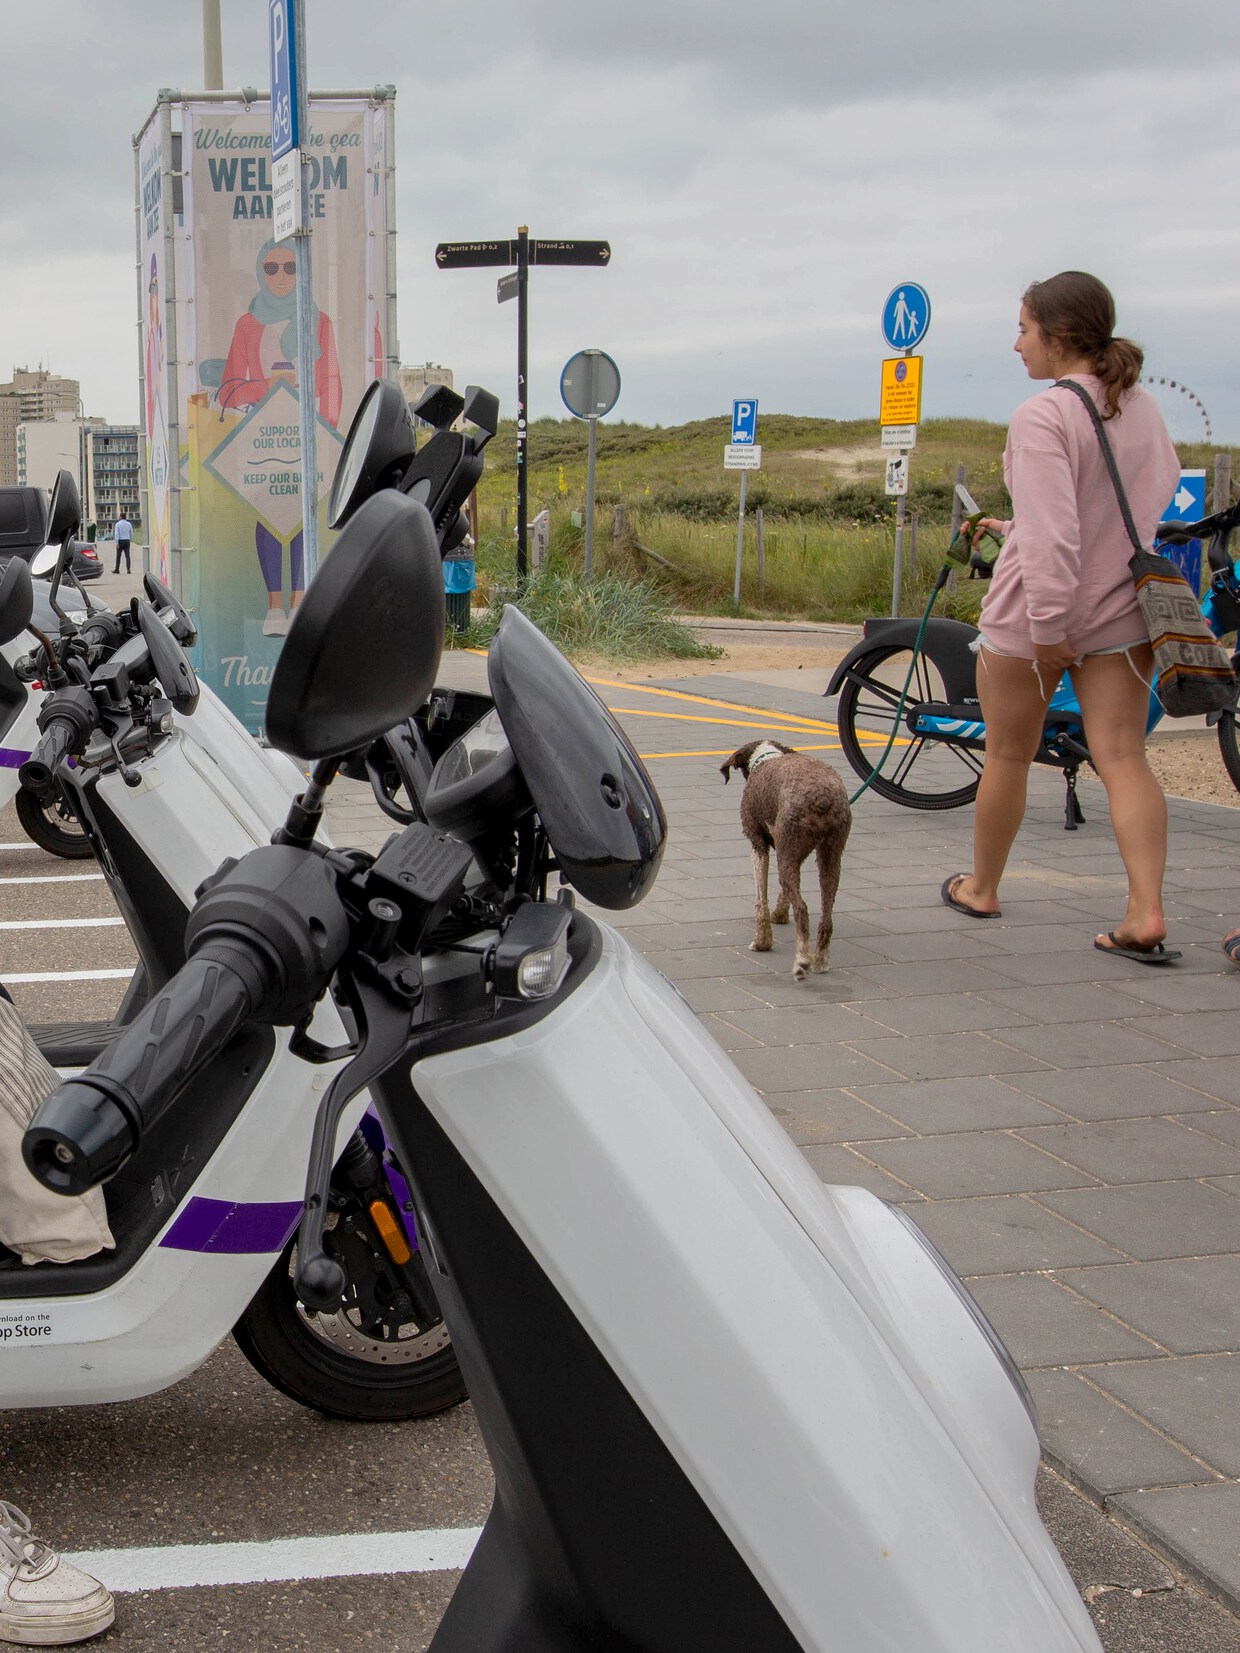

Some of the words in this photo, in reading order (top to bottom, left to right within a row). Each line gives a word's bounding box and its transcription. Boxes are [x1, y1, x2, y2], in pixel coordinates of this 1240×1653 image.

[195, 128, 272, 149] Welcome
[208, 154, 348, 192] WELOM
[737, 403, 751, 426] P
[260, 426, 300, 437] SUPPOR
[253, 438, 274, 449] OUR
[244, 473, 267, 484] KEEP
[269, 473, 290, 484] OUR
[269, 485, 298, 495] CLEAN
[37, 1313, 50, 1321] the
[15, 1324, 52, 1337] Store
